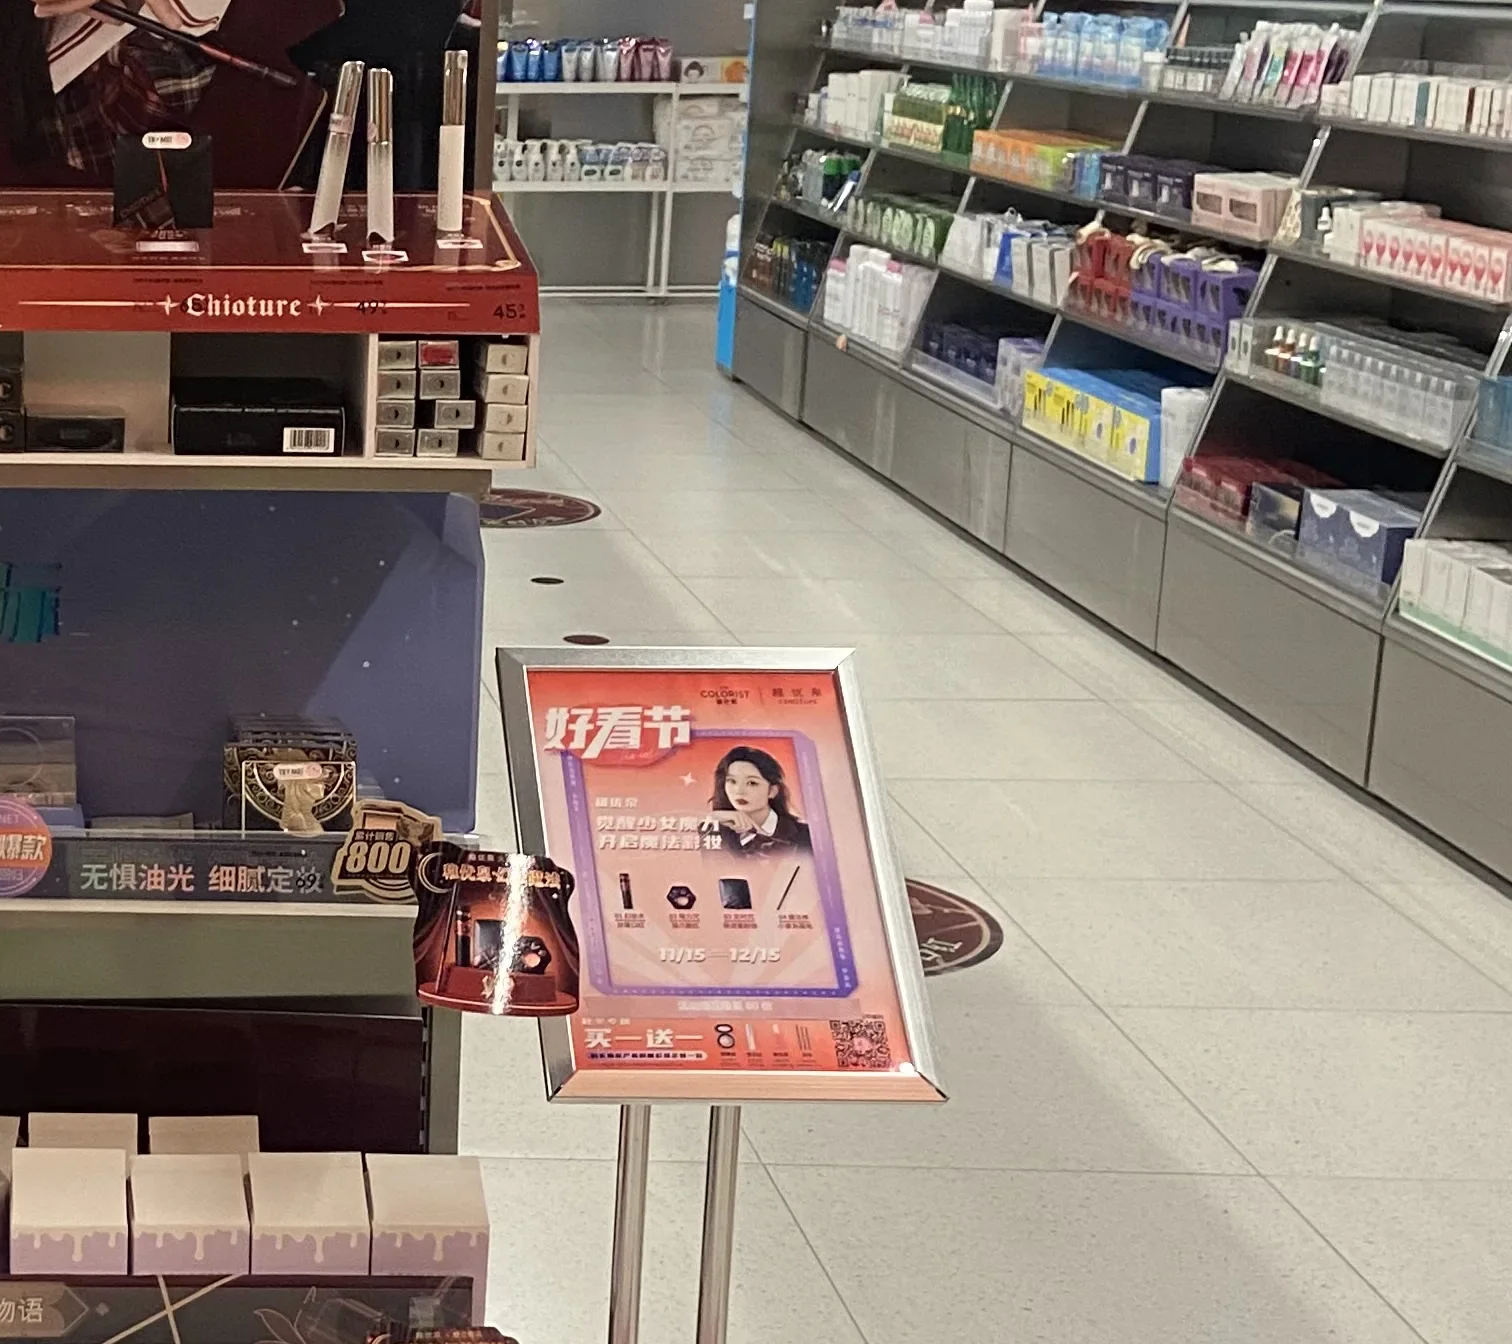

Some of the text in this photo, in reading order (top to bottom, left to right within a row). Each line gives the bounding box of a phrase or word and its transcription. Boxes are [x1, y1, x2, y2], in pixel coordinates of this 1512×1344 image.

[185, 292, 302, 317] Chioture
[493, 304, 518, 320] 45
[544, 705, 691, 760] 好看节
[345, 841, 412, 874] 800
[80, 863, 195, 893] 无惧油光
[295, 872, 317, 889] 69
[659, 946, 781, 964] 11/15 12/15
[584, 1027, 704, 1049] 买一送一
